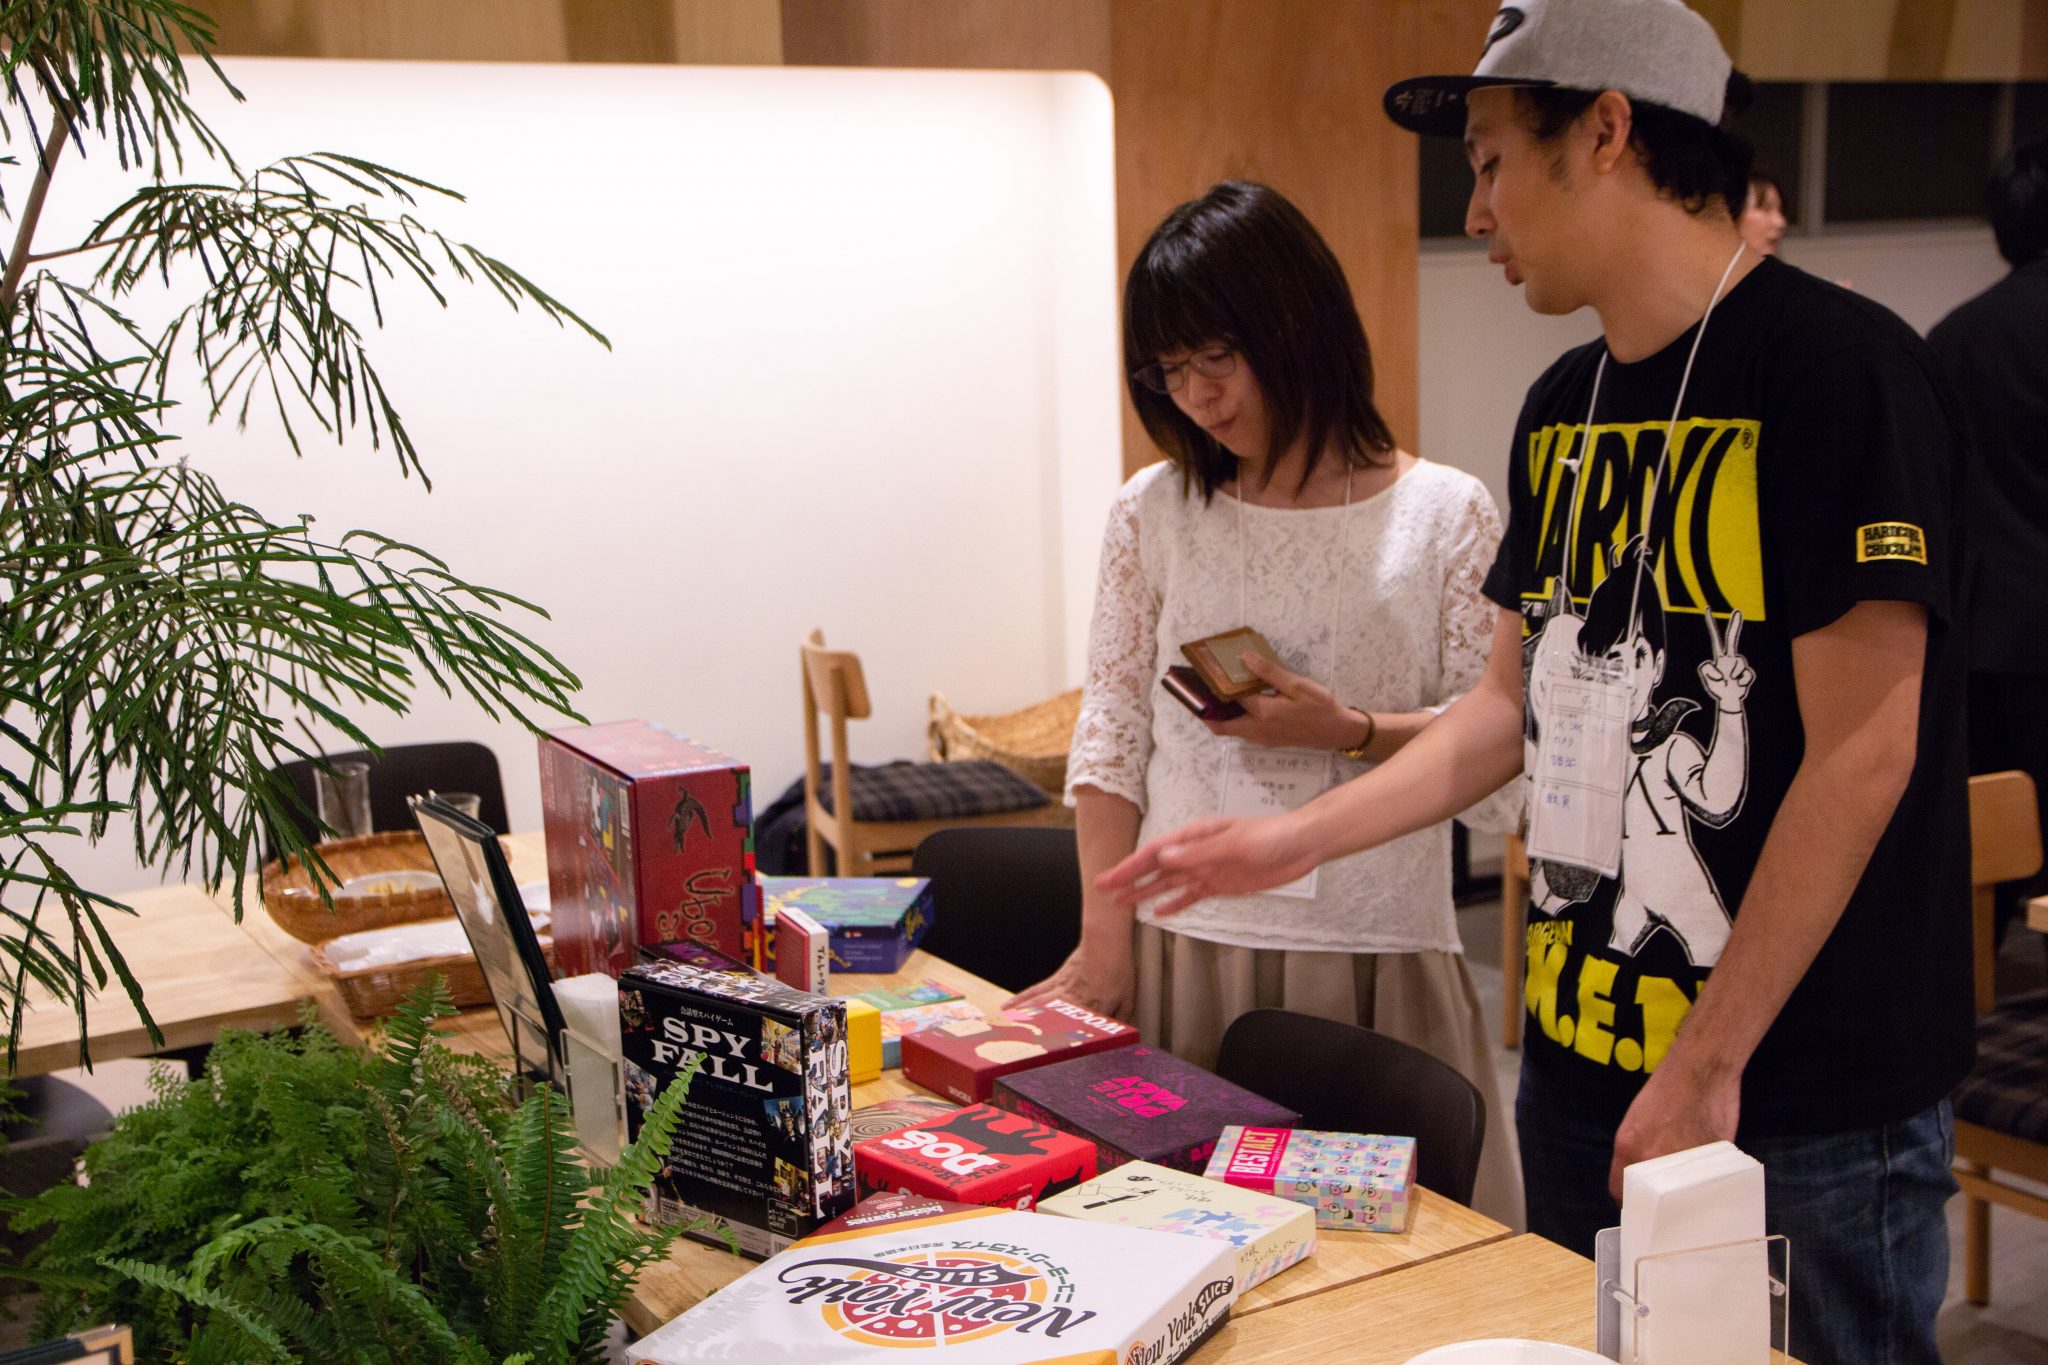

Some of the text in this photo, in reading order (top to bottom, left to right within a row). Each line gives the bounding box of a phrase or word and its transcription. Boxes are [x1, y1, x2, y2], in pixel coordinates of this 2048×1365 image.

[663, 1016, 751, 1059] SPY
[651, 1039, 773, 1092] FALL
[809, 1043, 833, 1219] FALL
[830, 1039, 853, 1178] SPY
[881, 1130, 1001, 1176] Dog
[895, 1266, 1000, 1284] SLICE
[1198, 1282, 1229, 1314] SLICE
[780, 1275, 1097, 1338] New York
[1134, 1335, 1165, 1365] New
[1167, 1301, 1197, 1348] York
